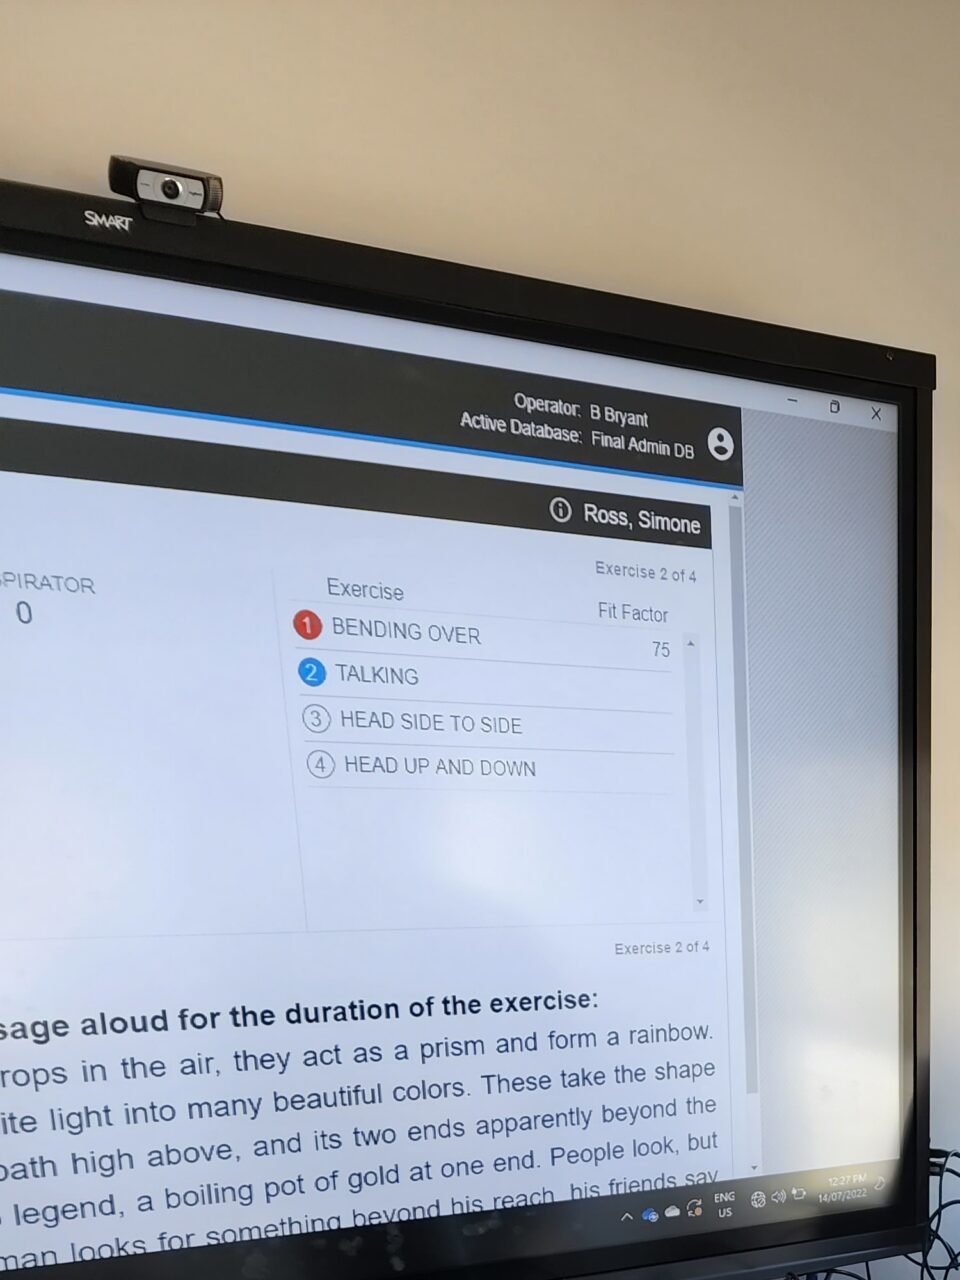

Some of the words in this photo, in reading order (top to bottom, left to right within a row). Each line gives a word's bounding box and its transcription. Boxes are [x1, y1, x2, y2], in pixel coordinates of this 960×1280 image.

[84, 210, 134, 232] SMART
[514, 392, 582, 418] Operator:
[590, 403, 602, 421] B
[604, 406, 649, 428] Bryant
[459, 411, 507, 433] Active
[509, 418, 583, 444] Database:
[591, 430, 626, 450] Final
[627, 436, 671, 457] Admin
[673, 442, 695, 460] DB
[583, 503, 633, 531] Ross,
[638, 509, 701, 534] Simone
[595, 560, 656, 580] Exercise
[659, 566, 669, 581] 2
[671, 568, 686, 583] of
[688, 569, 697, 584] 4
[326, 576, 405, 602] Exercise
[15, 600, 33, 625] 0
[597, 601, 618, 620] Fit
[621, 603, 670, 624] Factor
[302, 616, 312, 634] 1
[331, 616, 423, 641] BENDING
[427, 624, 483, 646] OVER
[651, 640, 671, 658] 75
[305, 663, 318, 682] 2
[334, 663, 420, 686] TALKING
[310, 709, 323, 728] 3
[340, 709, 396, 730] HEAD
[400, 712, 446, 732] SIDE
[448, 714, 476, 733] TO
[479, 716, 524, 735] SIDE
[314, 755, 327, 774] 4
[344, 755, 399, 774] HEAD
[403, 756, 430, 775] UP
[435, 757, 475, 776] AND
[479, 759, 537, 777] DOWN
[614, 942, 672, 956] Exercise
[674, 940, 684, 954] 2
[685, 940, 700, 953] of
[701, 939, 711, 952] 4
[80, 1008, 169, 1037] aloud
[177, 1007, 222, 1031] for
[228, 1004, 277, 1028] the
[285, 999, 400, 1025] duration
[408, 995, 436, 1018] of
[441, 994, 482, 1017] the
[489, 989, 598, 1014] exercise:
[0, 1066, 69, 1093] rops
[80, 1059, 108, 1083] in
[120, 1056, 167, 1080] the
[179, 1052, 221, 1078] air,
[232, 1049, 291, 1076] they
[302, 1043, 343, 1068] act
[352, 1045, 383, 1064] as
[393, 1043, 410, 1061] a
[419, 1036, 485, 1065] prism
[495, 1031, 538, 1054] and
[546, 1029, 597, 1051] form
[606, 1030, 620, 1047] a
[629, 1022, 713, 1045] rainbow.
[0, 1111, 38, 1136] ite
[49, 1104, 115, 1136] light
[123, 1100, 177, 1125] into
[187, 1096, 263, 1121] many
[272, 1082, 383, 1113] beautiful
[392, 1079, 472, 1103] colors.
[480, 1073, 552, 1095] These
[559, 1067, 606, 1089] take
[613, 1064, 647, 1085] the
[654, 1060, 716, 1084] shape
[70, 1147, 135, 1179] high
[147, 1143, 241, 1168] above,
[252, 1131, 302, 1157] and
[313, 1129, 343, 1152] its
[352, 1126, 397, 1148] two
[407, 1117, 466, 1142] ends
[475, 1106, 593, 1140] apparently
[601, 1097, 677, 1126] beyond
[685, 1095, 717, 1115] the
[12, 1193, 125, 1229] legend,
[136, 1194, 155, 1213] a
[164, 1182, 254, 1210] boiling
[264, 1174, 306, 1205] pot
[313, 1169, 340, 1193] of
[347, 1163, 400, 1195] gold
[409, 1160, 434, 1182] at
[440, 1159, 485, 1179] one
[492, 1149, 541, 1173] end.
[550, 1141, 625, 1167] People
[632, 1135, 679, 1158] look,
[687, 1131, 718, 1152] but
[714, 1191, 736, 1203] ENG
[70, 1236, 148, 1264] looks
[156, 1230, 197, 1252] for
[205, 1214, 342, 1246] something
[351, 1198, 442, 1228] beyond
[450, 1194, 485, 1216] his
[492, 1186, 555, 1210] reach
[569, 1180, 602, 1202] his
[608, 1171, 678, 1196] friends
[684, 1168, 720, 1188] say
[718, 1207, 733, 1218] US
